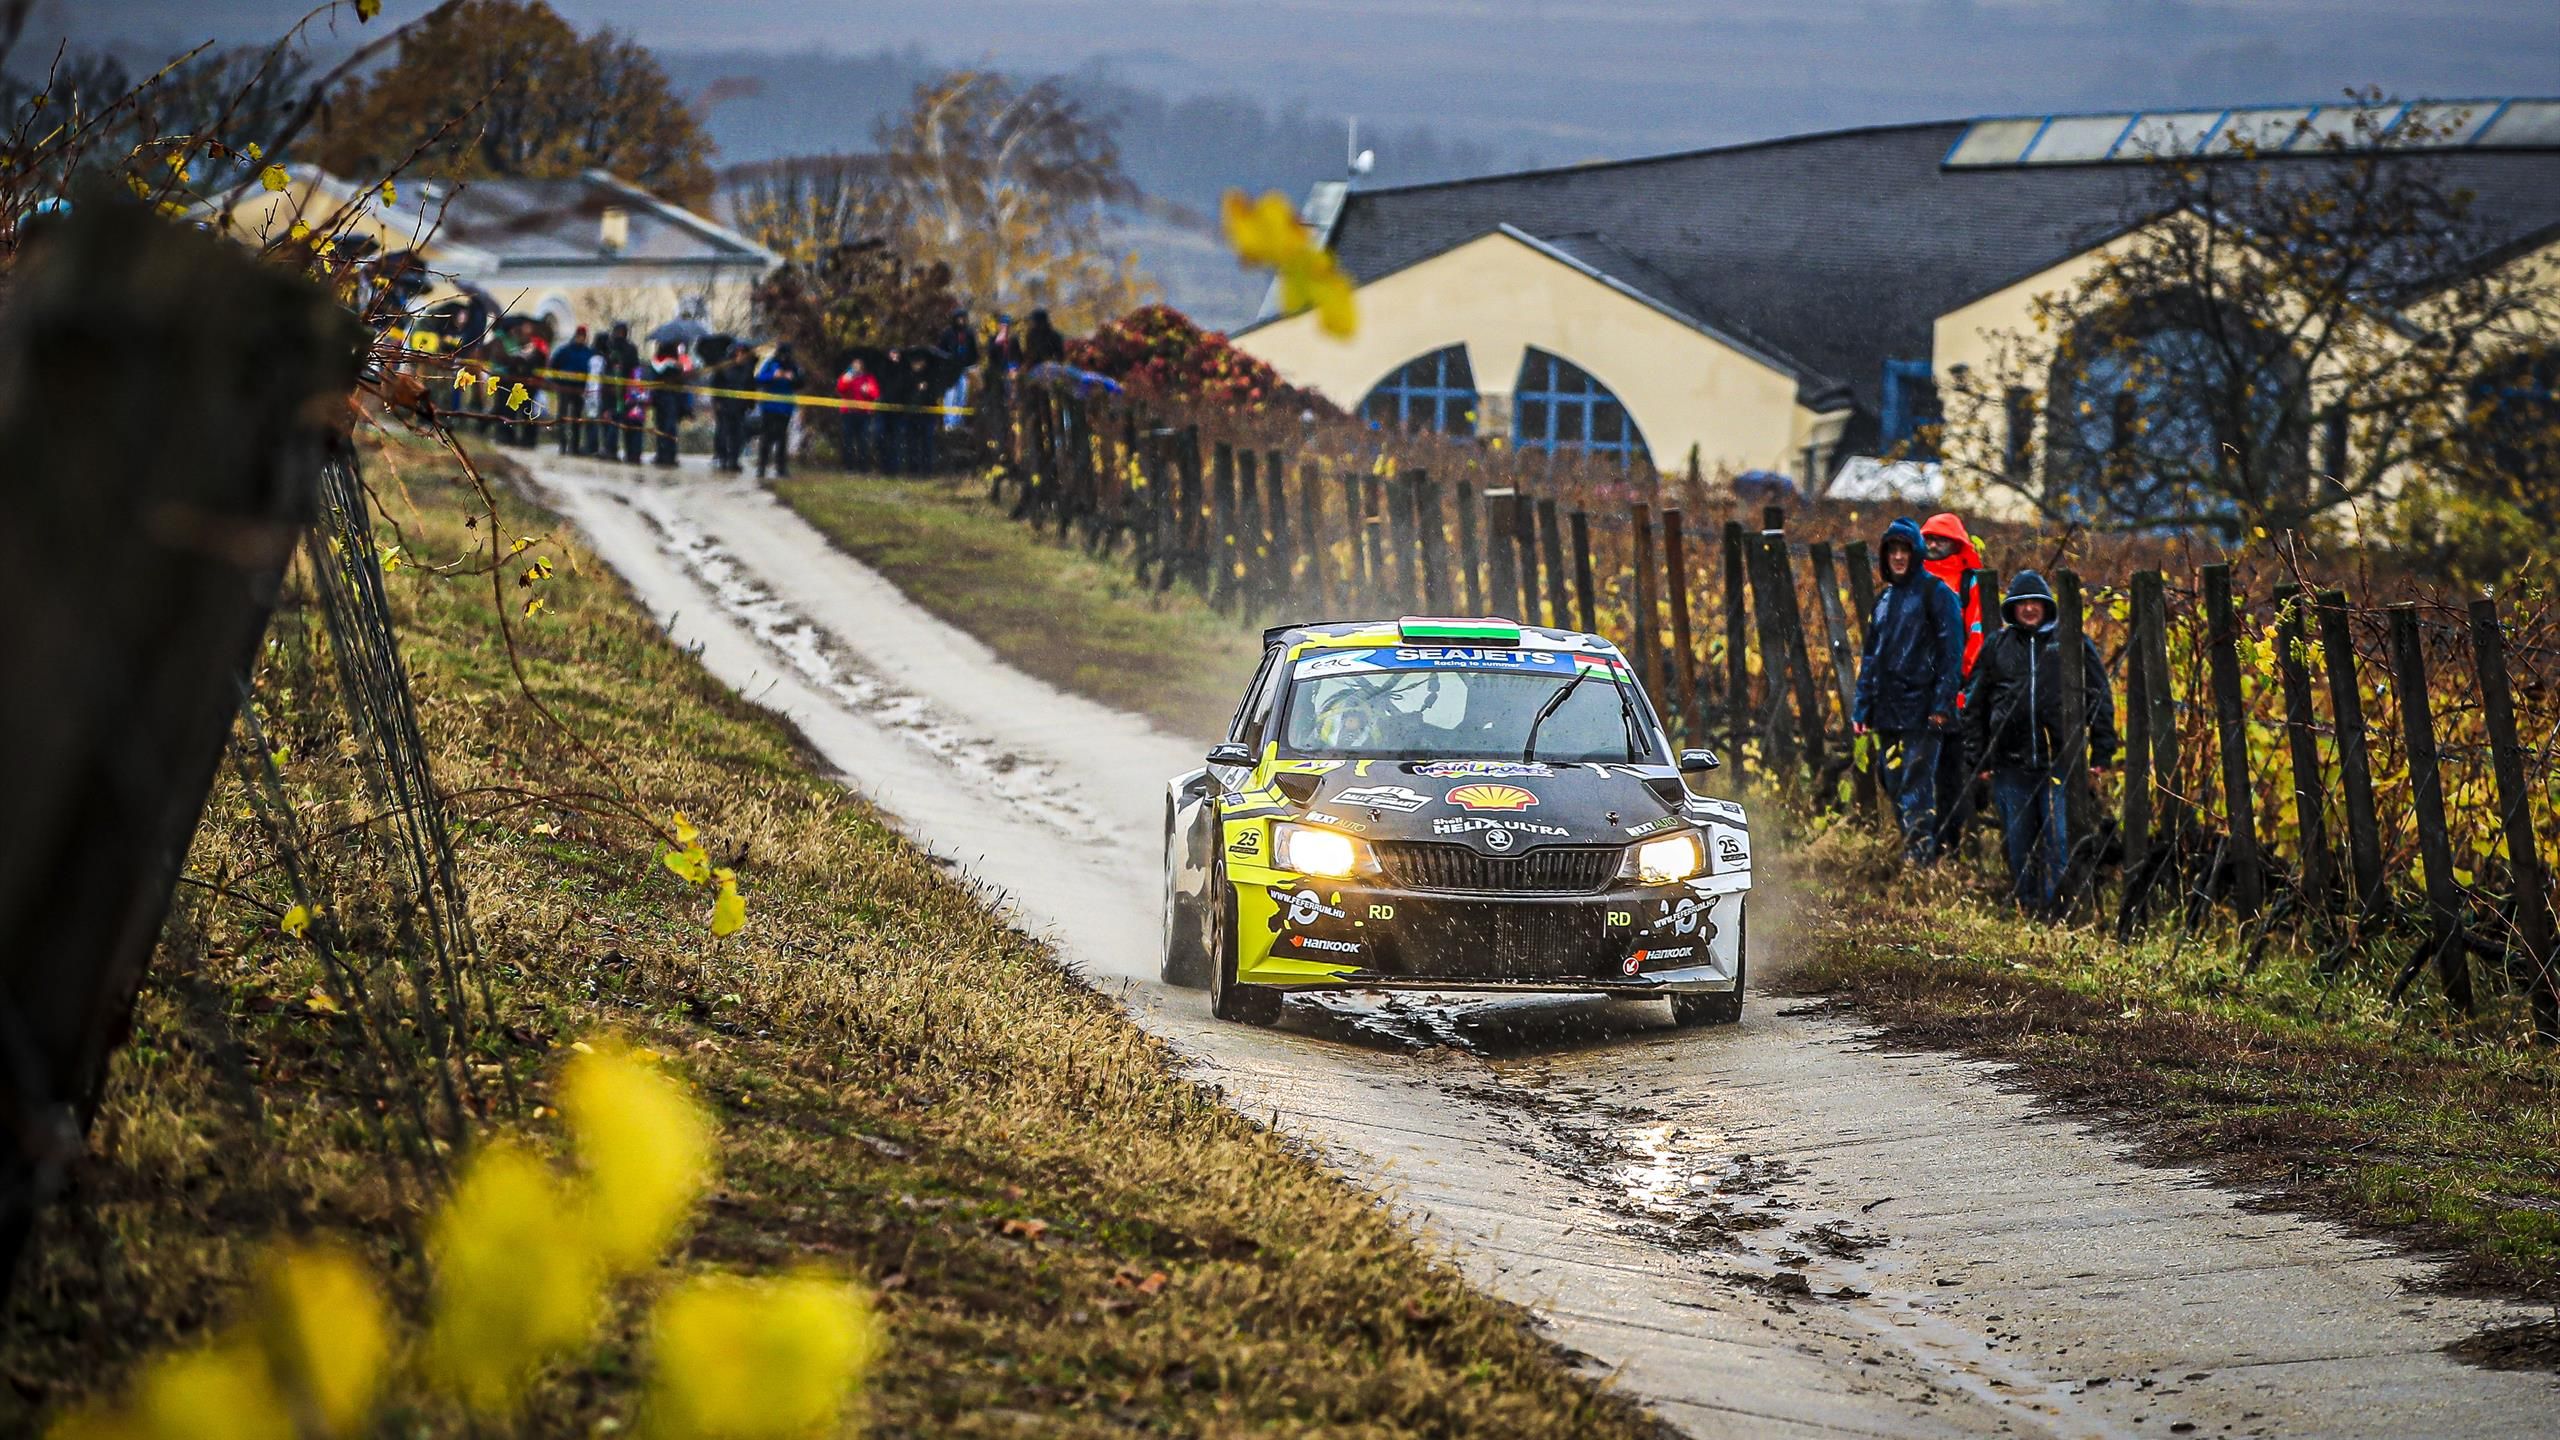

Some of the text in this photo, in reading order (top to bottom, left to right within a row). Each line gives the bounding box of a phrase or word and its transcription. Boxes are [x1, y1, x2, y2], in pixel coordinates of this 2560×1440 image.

[1395, 648, 1556, 665] SEAJETS
[1434, 660, 1467, 668] Racing
[1433, 817, 1462, 825] Shell
[1433, 818, 1570, 837] HELIX ULTRA
[1237, 831, 1259, 846] 25
[1718, 839, 1739, 853] 25
[1368, 904, 1394, 919] RD
[1607, 911, 1631, 926] RD
